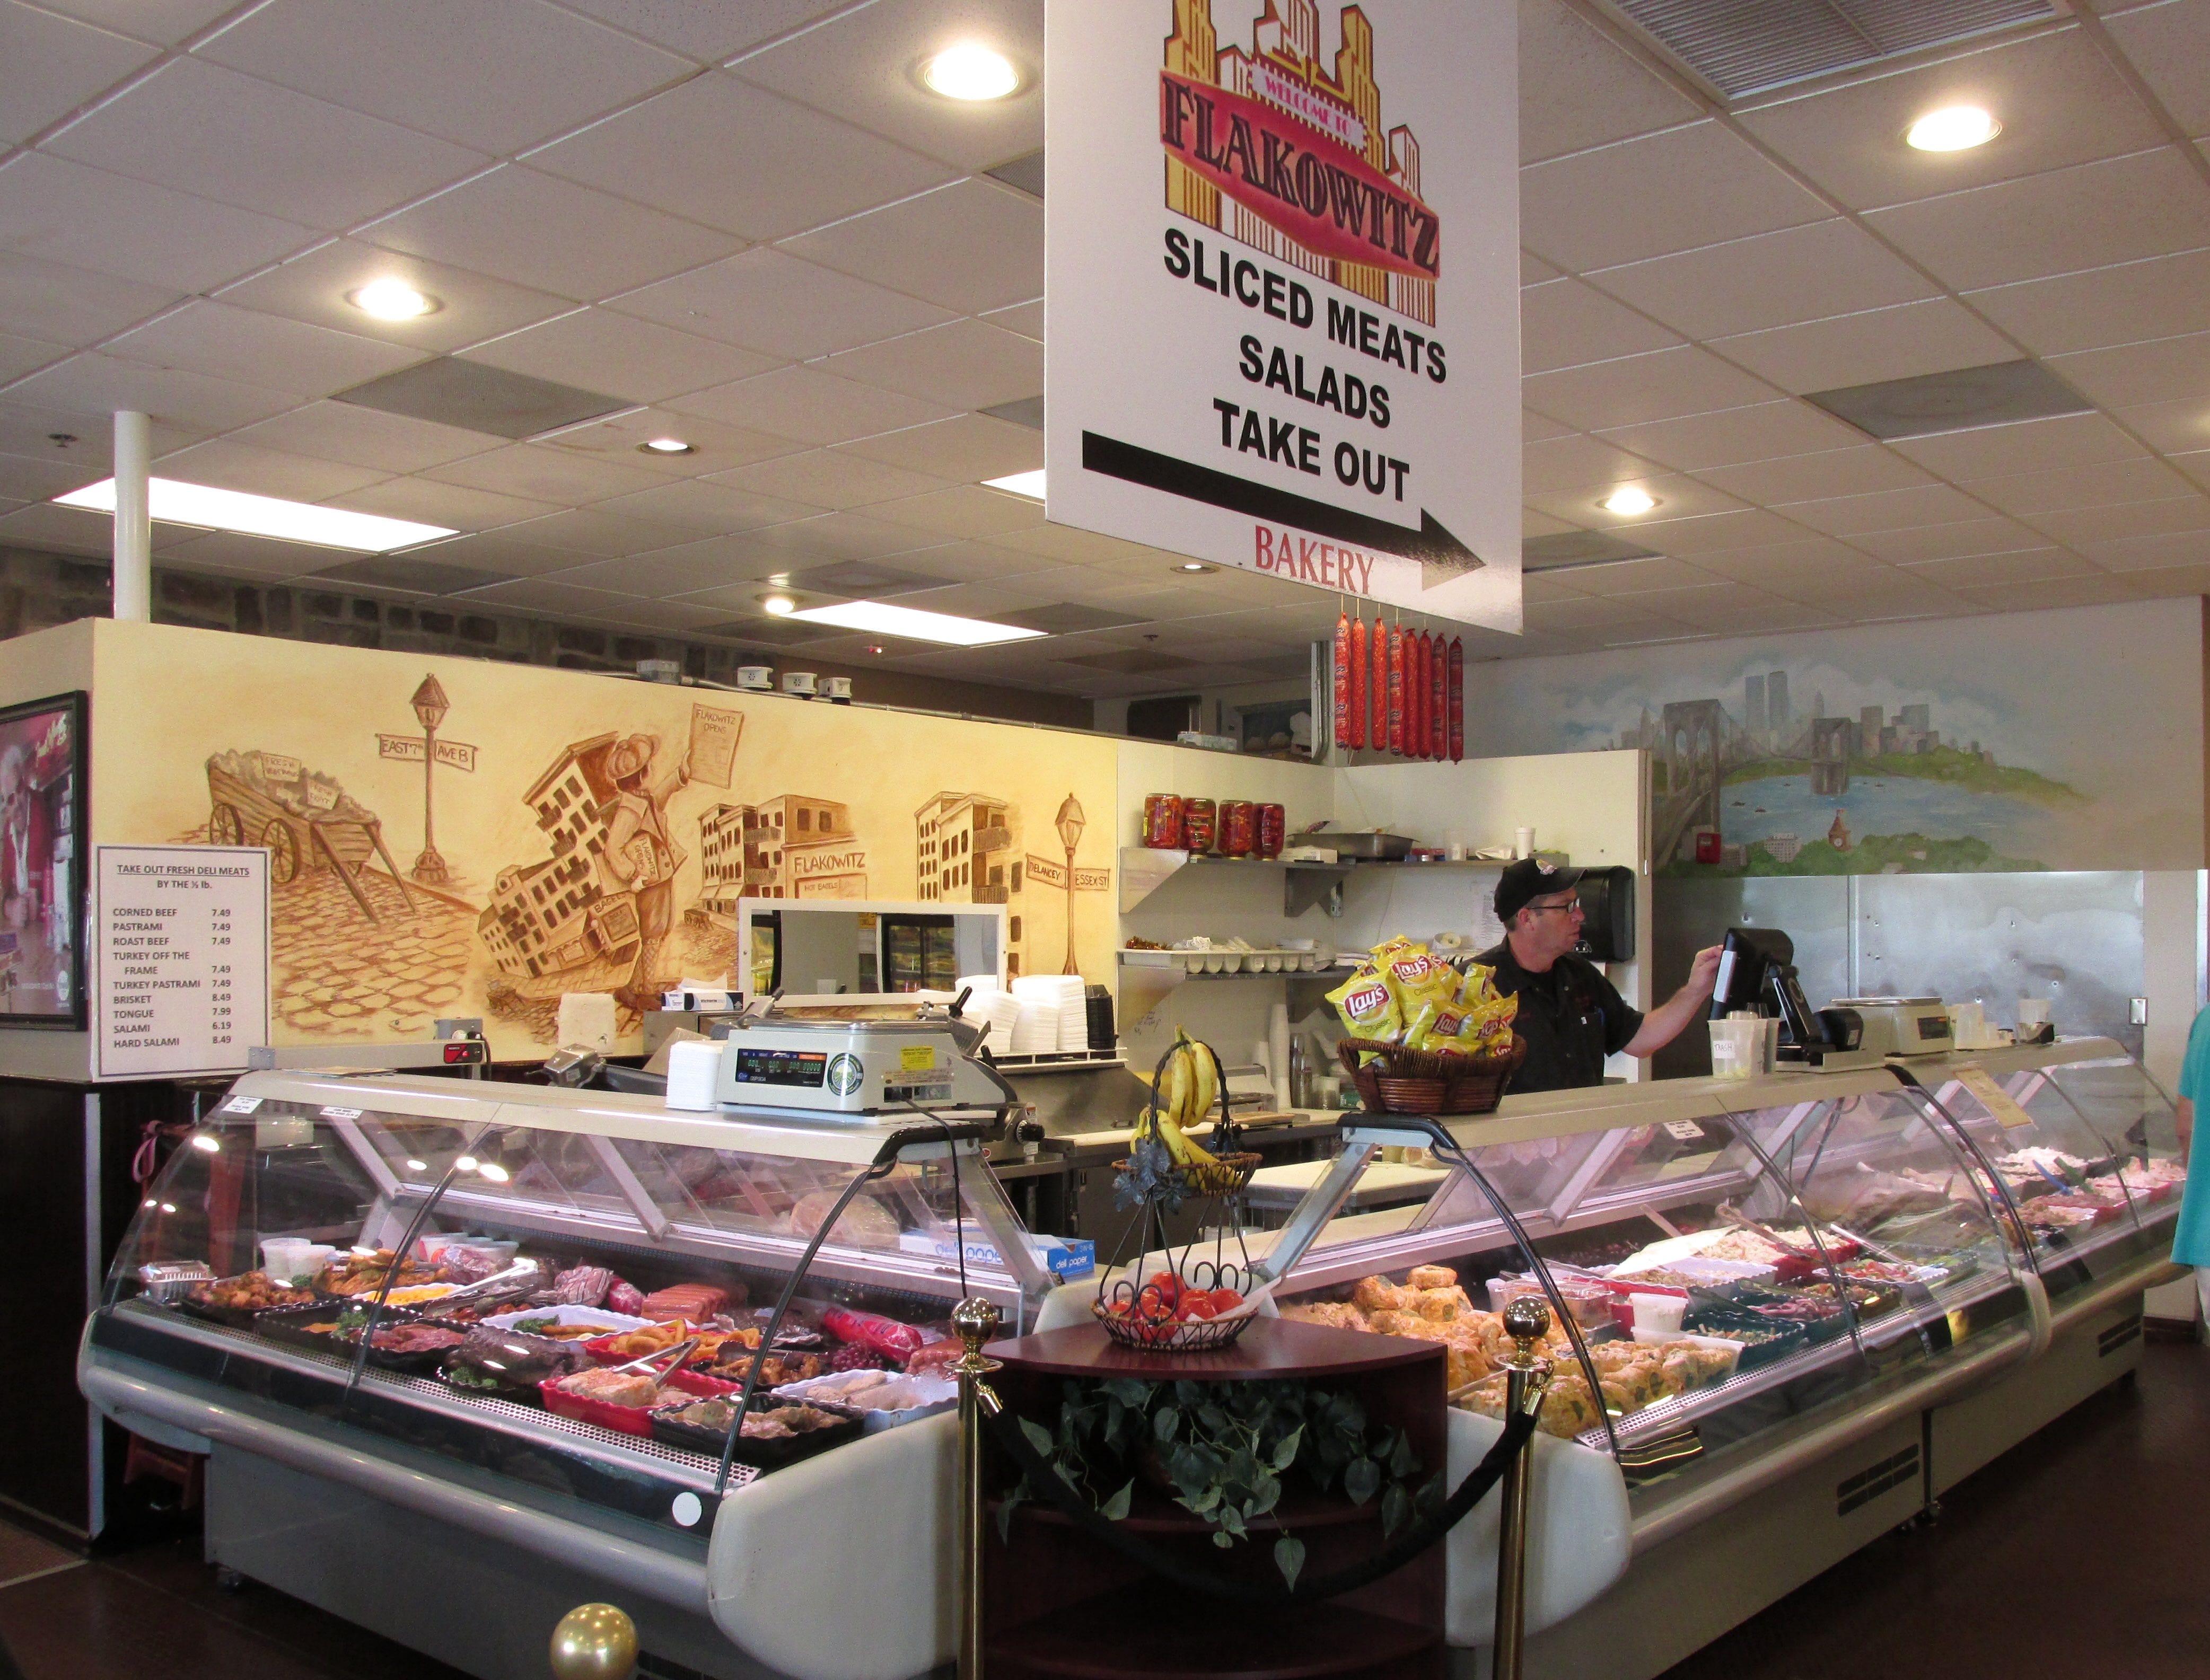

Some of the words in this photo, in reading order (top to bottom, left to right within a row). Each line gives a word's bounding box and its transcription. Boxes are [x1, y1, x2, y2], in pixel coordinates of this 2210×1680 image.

[1265, 75, 1330, 126] WELCOME
[1333, 115, 1353, 137] TO
[1162, 76, 1440, 278] FLAKOWITZ
[1164, 228, 1314, 329] SLICED
[1328, 297, 1447, 383] MEATS
[1239, 335, 1391, 428] SALADS
[1213, 398, 1321, 476] TAKE
[1334, 442, 1410, 502] OUT
[1255, 525, 1374, 596] BAKERY
[696, 709, 736, 725] FLAKOWITZ
[704, 723, 726, 734] OPENS
[382, 739, 409, 754] EAST
[437, 745, 456, 760] AVE
[459, 749, 469, 762] B
[639, 837, 656, 876] FLAKOWITZ
[794, 852, 866, 874] FLAKOWITZ
[117, 865, 141, 874] TAKE
[144, 865, 164, 874] OUT
[167, 866, 195, 874] FRESH
[198, 866, 216, 875] DELI
[219, 867, 250, 876] MEATS
[1029, 861, 1060, 881] DELANCEY
[157, 879, 169, 888] BY
[172, 880, 188, 889] THE
[818, 882, 838, 891] BAGELS
[1075, 874, 1098, 886] ESSEX
[1099, 876, 1107, 886] ST
[113, 908, 153, 917] CORNED
[156, 908, 177, 917] BEEF
[153, 980, 200, 989] PASTRAMI
[212, 979, 231, 988] 7.49
[1414, 982, 1437, 996] Classic
[113, 996, 152, 1004] BRISKET
[113, 1010, 154, 1019] TONGUE
[113, 1024, 150, 1033] SALAMI
[1365, 1018, 1391, 1033] Classic
[114, 1039, 141, 1048] HARD
[144, 1037, 179, 1046] SALAMI
[1056, 1259, 1067, 1269] deli
[1069, 1255, 1088, 1268] paper
